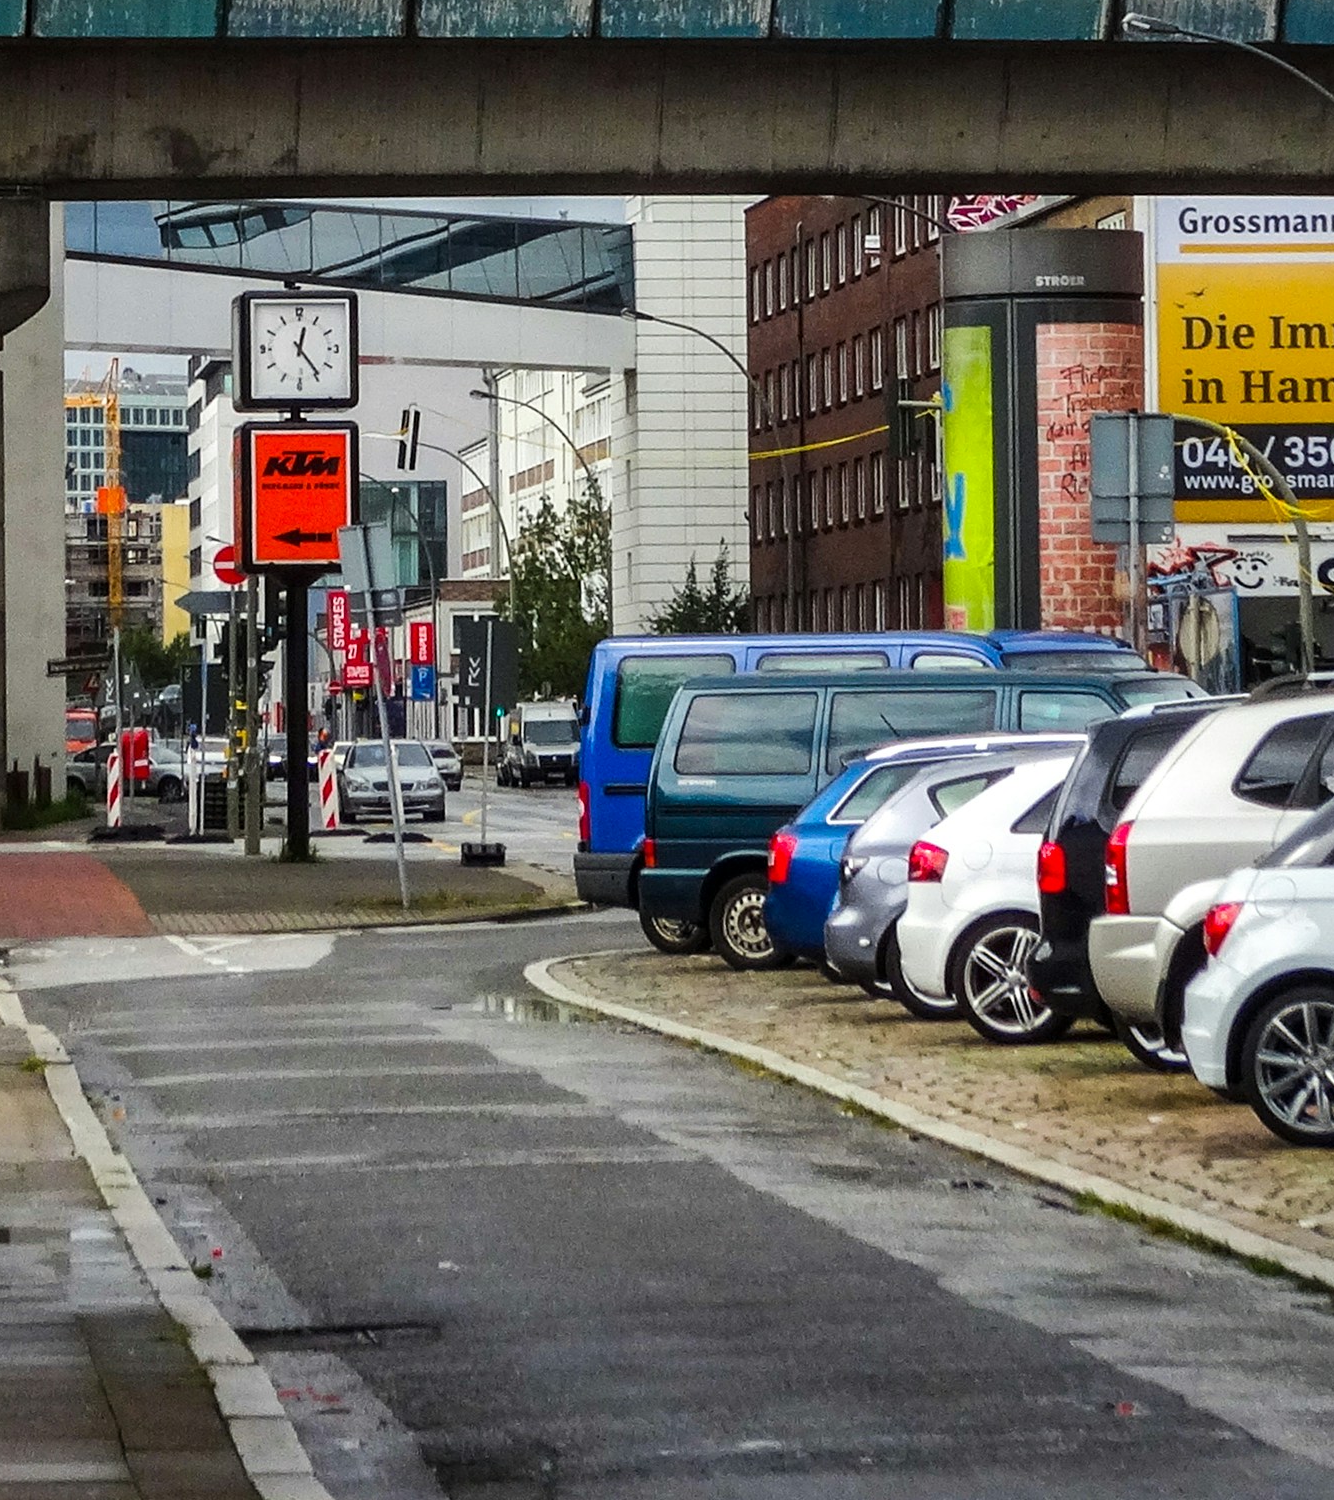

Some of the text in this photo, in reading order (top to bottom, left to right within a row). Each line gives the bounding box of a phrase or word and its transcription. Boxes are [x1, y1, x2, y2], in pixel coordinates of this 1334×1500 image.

[1181, 314, 1255, 350] Die
[1181, 368, 1227, 404] in
[262, 450, 341, 476] KTM
[332, 596, 345, 648] STAPLES
[418, 625, 427, 661] STAPLES
[346, 665, 369, 678] STAPLES
